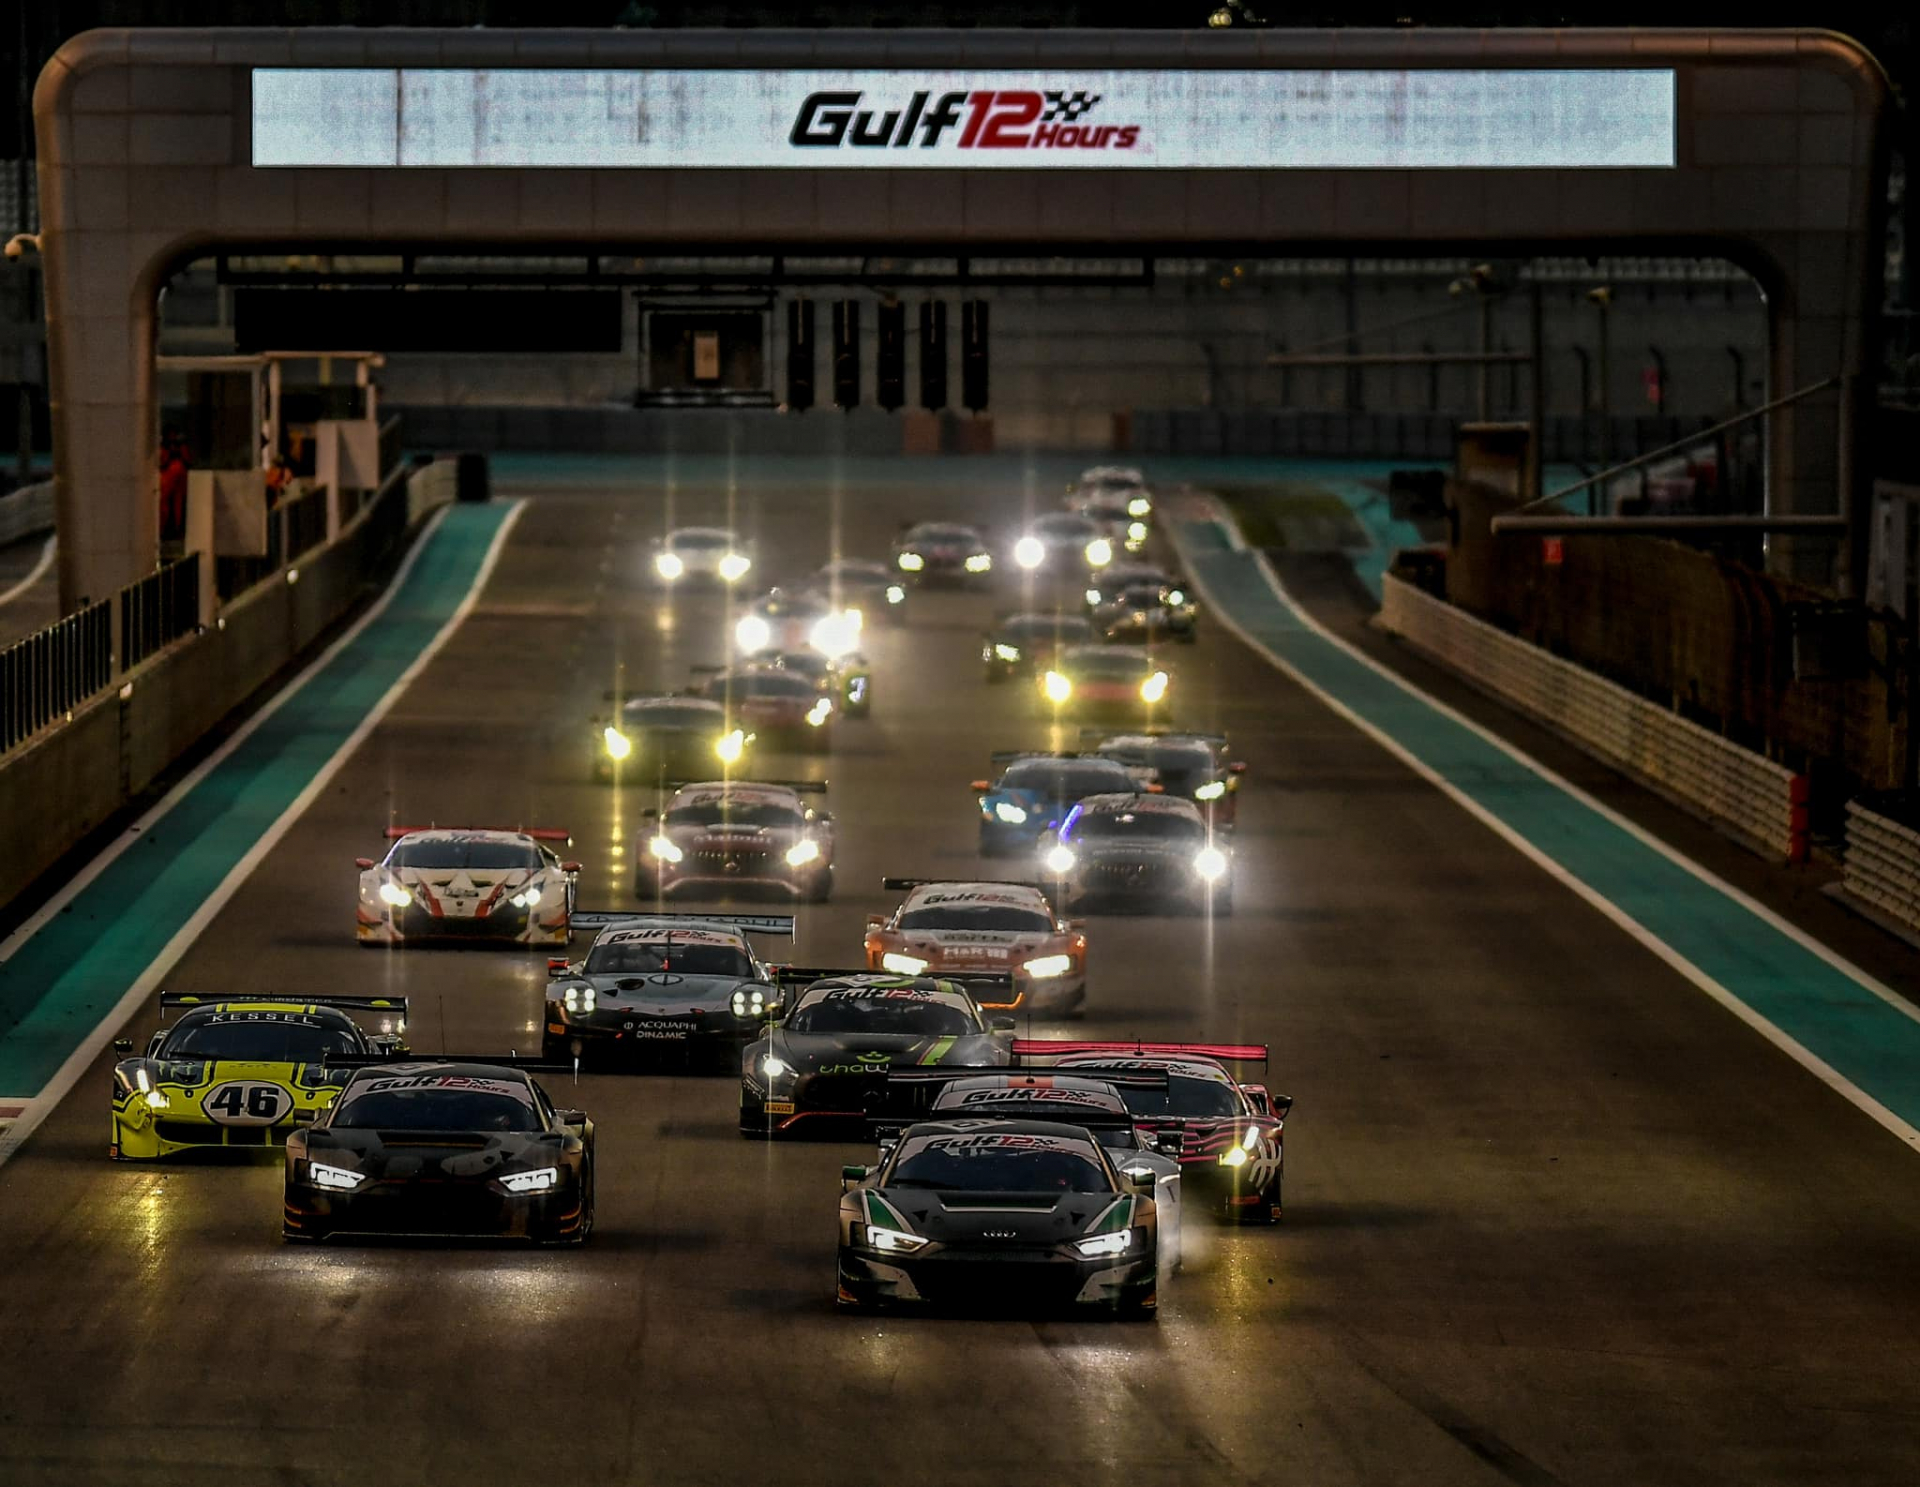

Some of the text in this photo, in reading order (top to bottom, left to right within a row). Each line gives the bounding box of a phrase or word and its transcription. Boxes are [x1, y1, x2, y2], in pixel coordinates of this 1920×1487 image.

[1030, 124, 1140, 148] Hours
[211, 1012, 315, 1025] KESSEL
[636, 1030, 687, 1040] DINAMIC
[209, 1085, 280, 1118] 46
